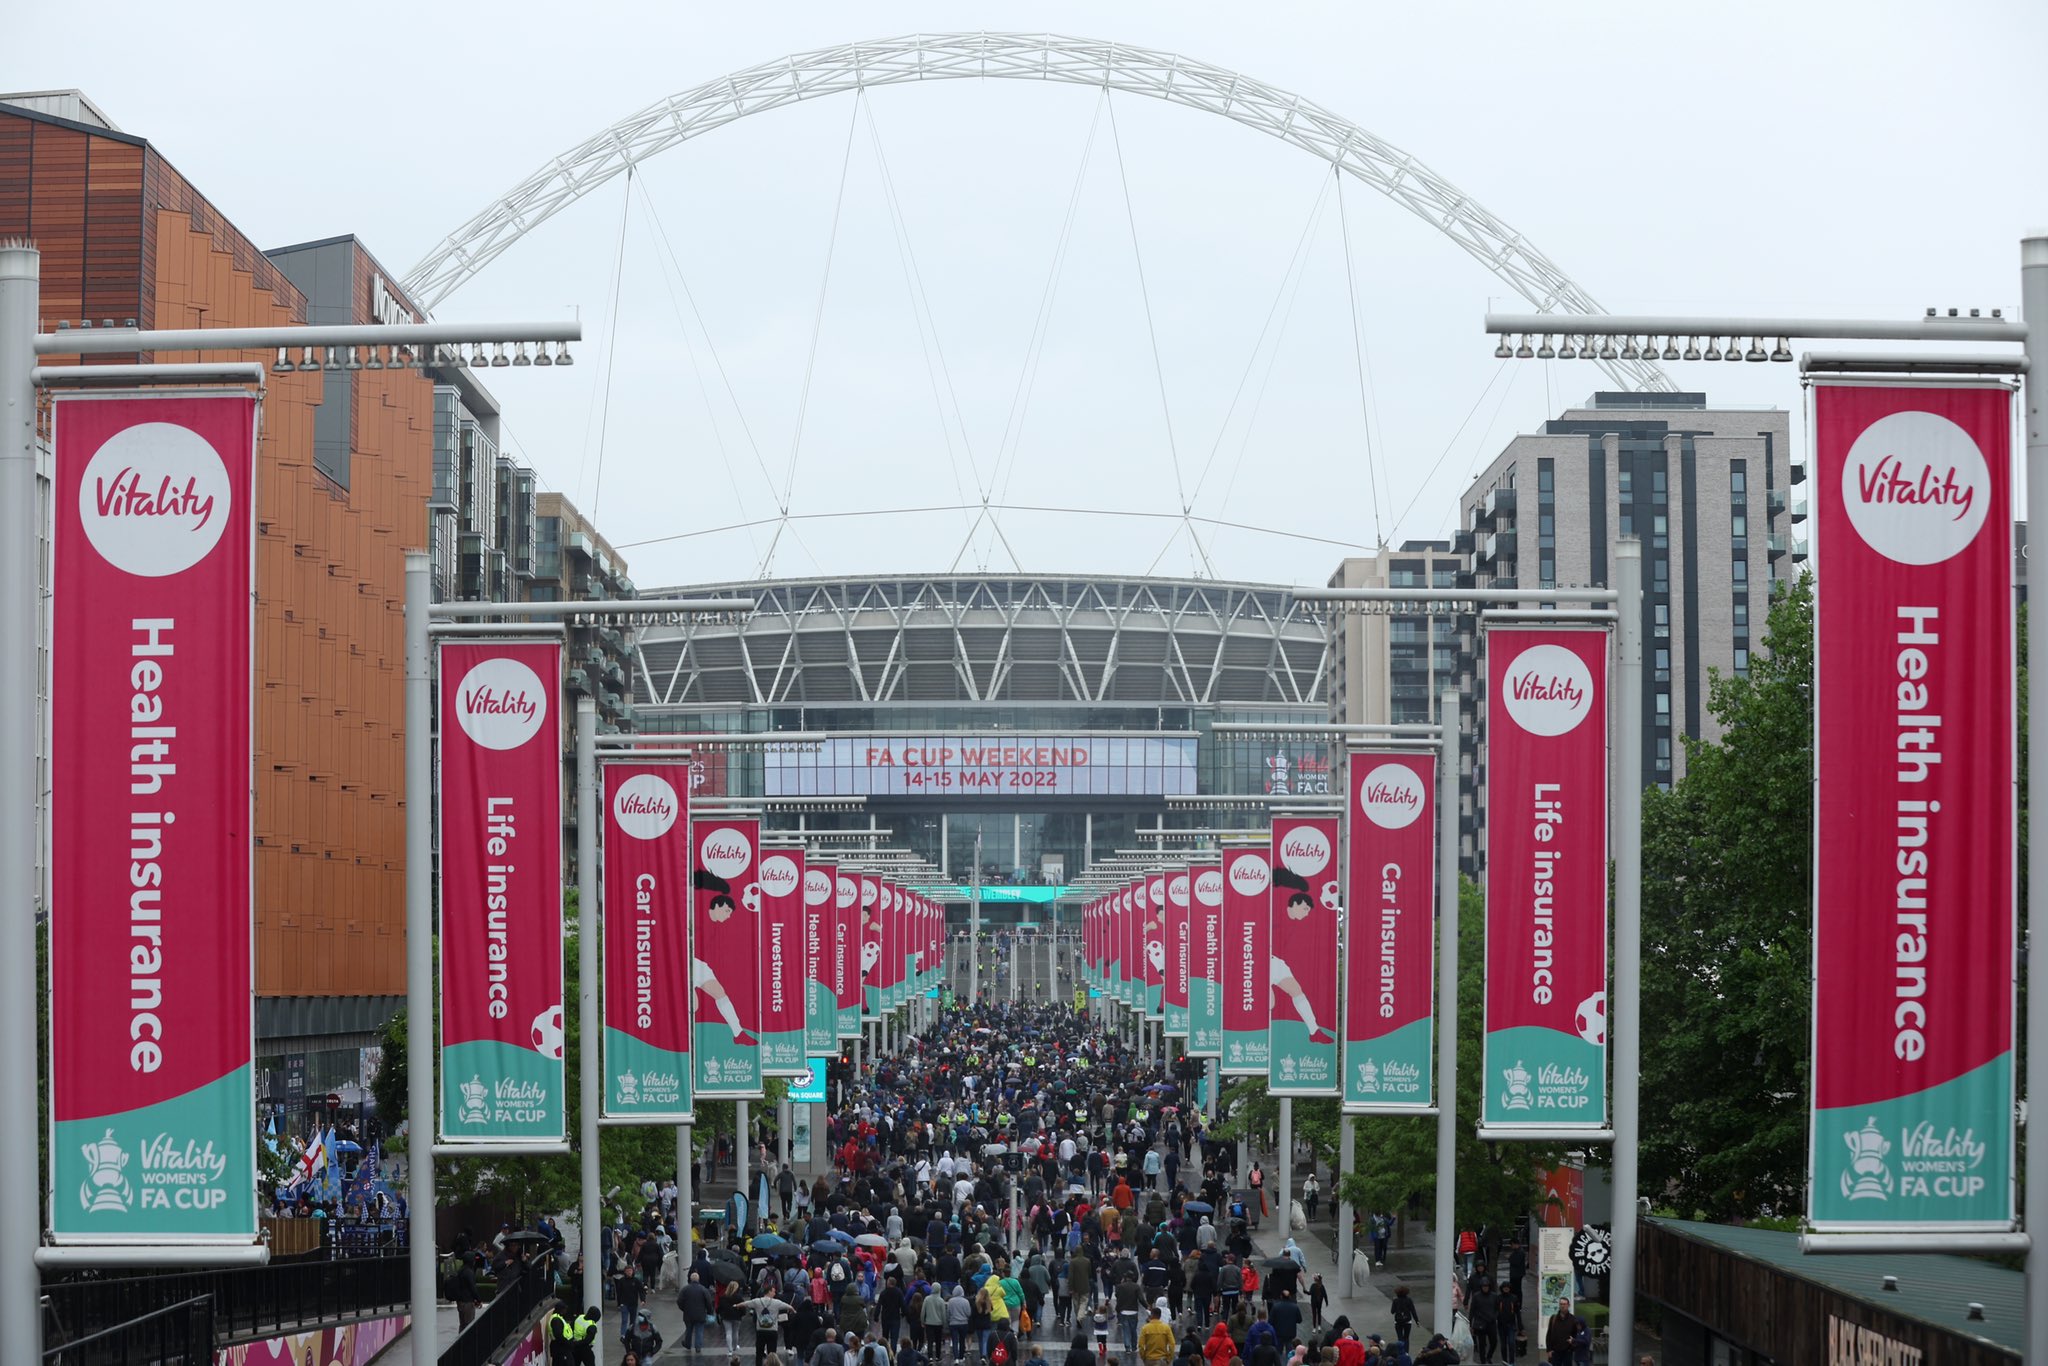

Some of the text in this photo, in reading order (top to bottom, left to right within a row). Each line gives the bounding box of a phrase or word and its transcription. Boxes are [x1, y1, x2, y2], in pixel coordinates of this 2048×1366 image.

[1859, 455, 1973, 520] Vitality
[96, 466, 214, 531] Vitality
[1513, 670, 1583, 710] Vitality
[466, 684, 536, 722] Vitality
[866, 748, 1088, 766] FA CUP WEEKEND
[904, 772, 1057, 786] 14-15 MAY 2022
[1297, 782, 1312, 792] FA
[621, 792, 670, 820] Vitality
[1367, 782, 1418, 810] Vitality
[1895, 606, 1941, 1061] Health insurance
[131, 618, 176, 1072] Health insurance
[706, 844, 746, 864] Vitality
[1285, 840, 1325, 861] Vitality
[761, 868, 794, 884] Vitality
[1234, 868, 1265, 883] Vitality
[805, 881, 828, 894] itality
[1198, 882, 1222, 894] Vitalit
[1533, 784, 1562, 1005] Life insurance
[487, 797, 515, 1018] Life insurance
[1207, 915, 1218, 954] Health
[1380, 863, 1401, 1018] Car insurance
[636, 873, 656, 1029] Car insurance
[772, 922, 784, 1012] Investments
[809, 914, 820, 1015] Health insurance
[1243, 922, 1255, 1011] Investments
[1207, 957, 1218, 1016] insurance
[723, 1059, 752, 1072] Vitality
[1299, 1056, 1327, 1069] Vitality
[1383, 1060, 1419, 1078] Vitality
[642, 1070, 680, 1088] Vitality
[1538, 1062, 1588, 1091] Vitality
[495, 1076, 546, 1106] Vitality
[1383, 1083, 1419, 1092] FA CUP
[1538, 1086, 1577, 1094] WOMEN'S
[495, 1100, 534, 1108] WOMEN'S
[643, 1094, 679, 1103] FA CUP
[1537, 1096, 1588, 1107] FA CUP
[495, 1110, 546, 1122] FA CUP
[1902, 1121, 1985, 1168] Vitality
[141, 1132, 226, 1181] Vitality
[1902, 1161, 1965, 1173] WOMEN'S
[141, 1172, 206, 1184] WOMEN'S
[1900, 1176, 1984, 1196] FA CUP
[141, 1188, 226, 1209] FA CUP
